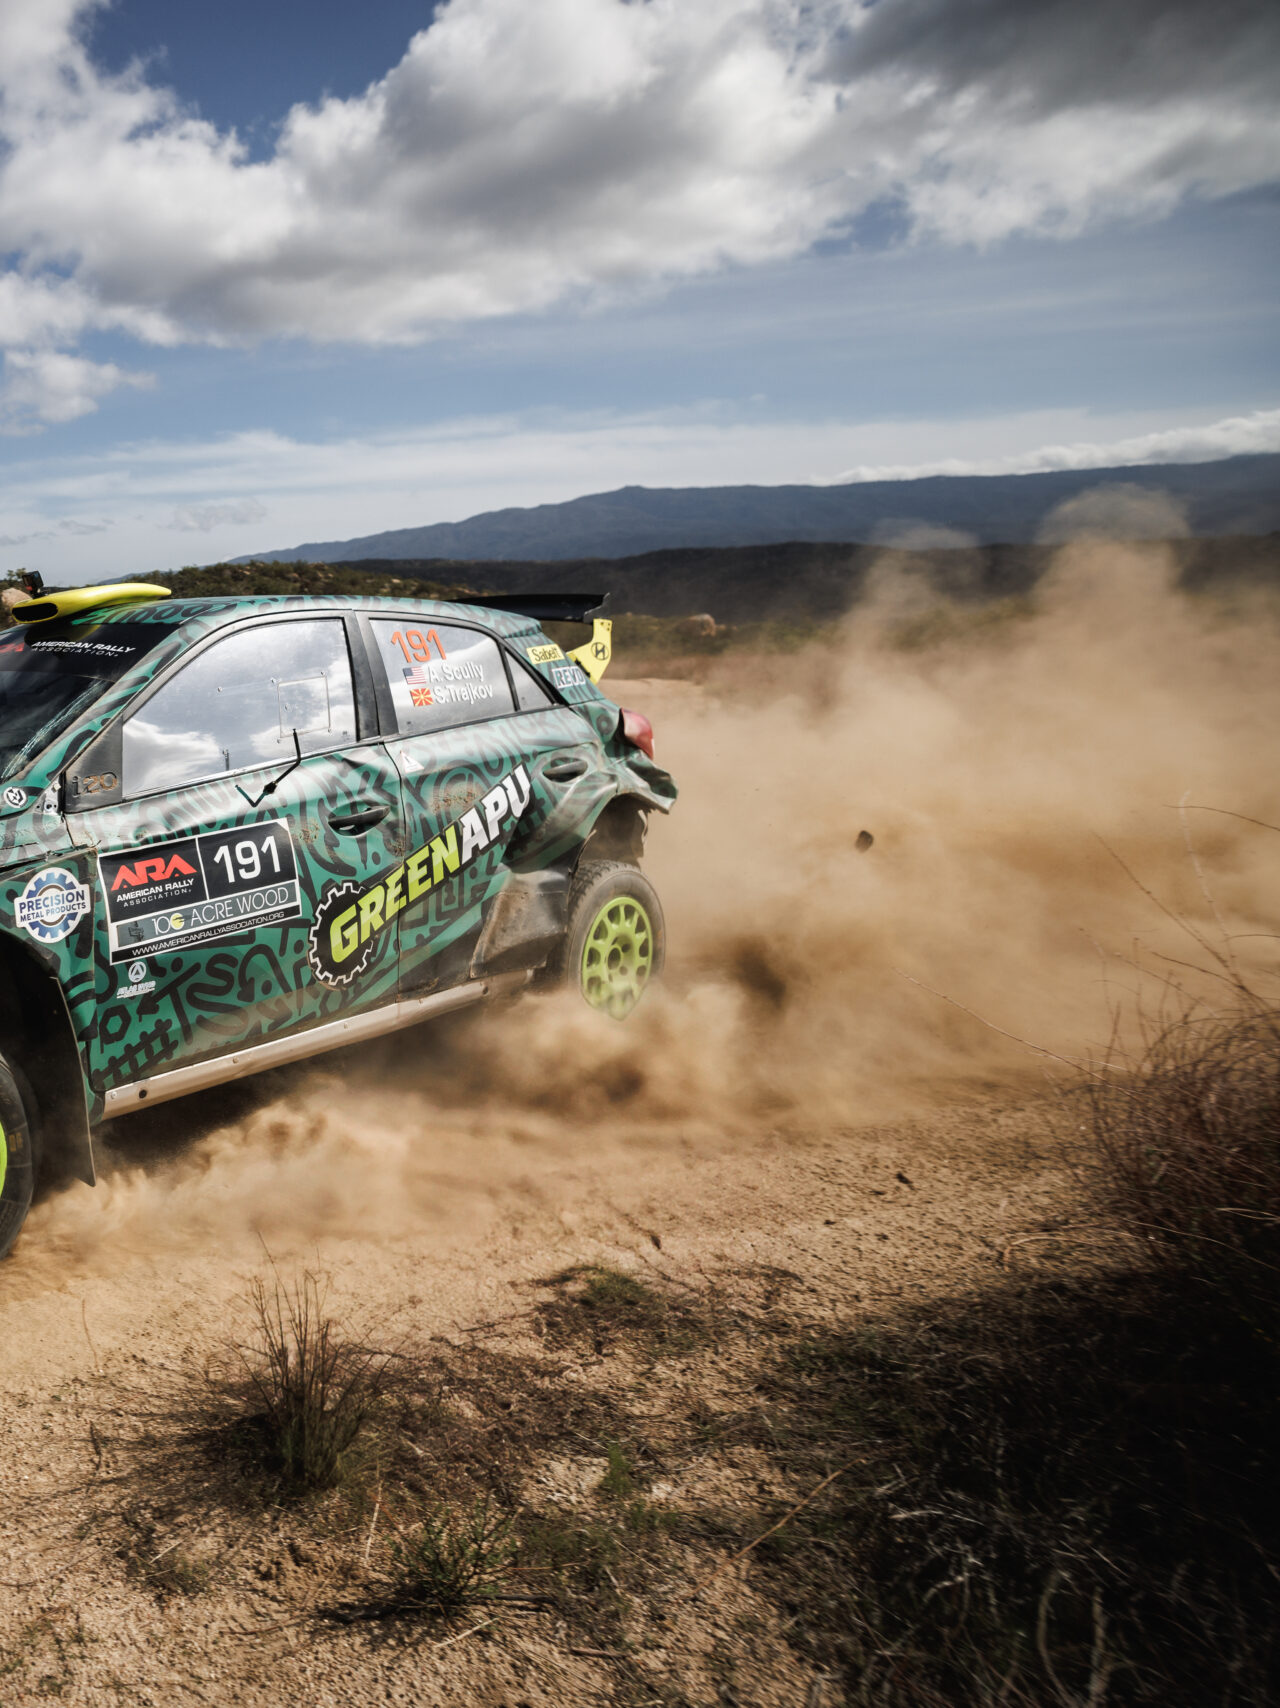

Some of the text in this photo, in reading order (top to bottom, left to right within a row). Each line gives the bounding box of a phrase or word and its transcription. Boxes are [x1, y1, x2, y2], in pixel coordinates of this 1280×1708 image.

[31, 641, 137, 653] AMERICAN RALLY
[390, 628, 447, 663] 191
[111, 854, 198, 891] ARA
[213, 835, 281, 884] 191
[329, 764, 531, 963] GREENAPU
[19, 889, 85, 914] PRECISION
[116, 878, 195, 903] AMERICAN RALLY
[123, 889, 187, 908] ASSOCIATION
[20, 902, 87, 923] METAL PRODUCTS
[190, 900, 234, 928] ACRE
[236, 887, 289, 912] WOOD
